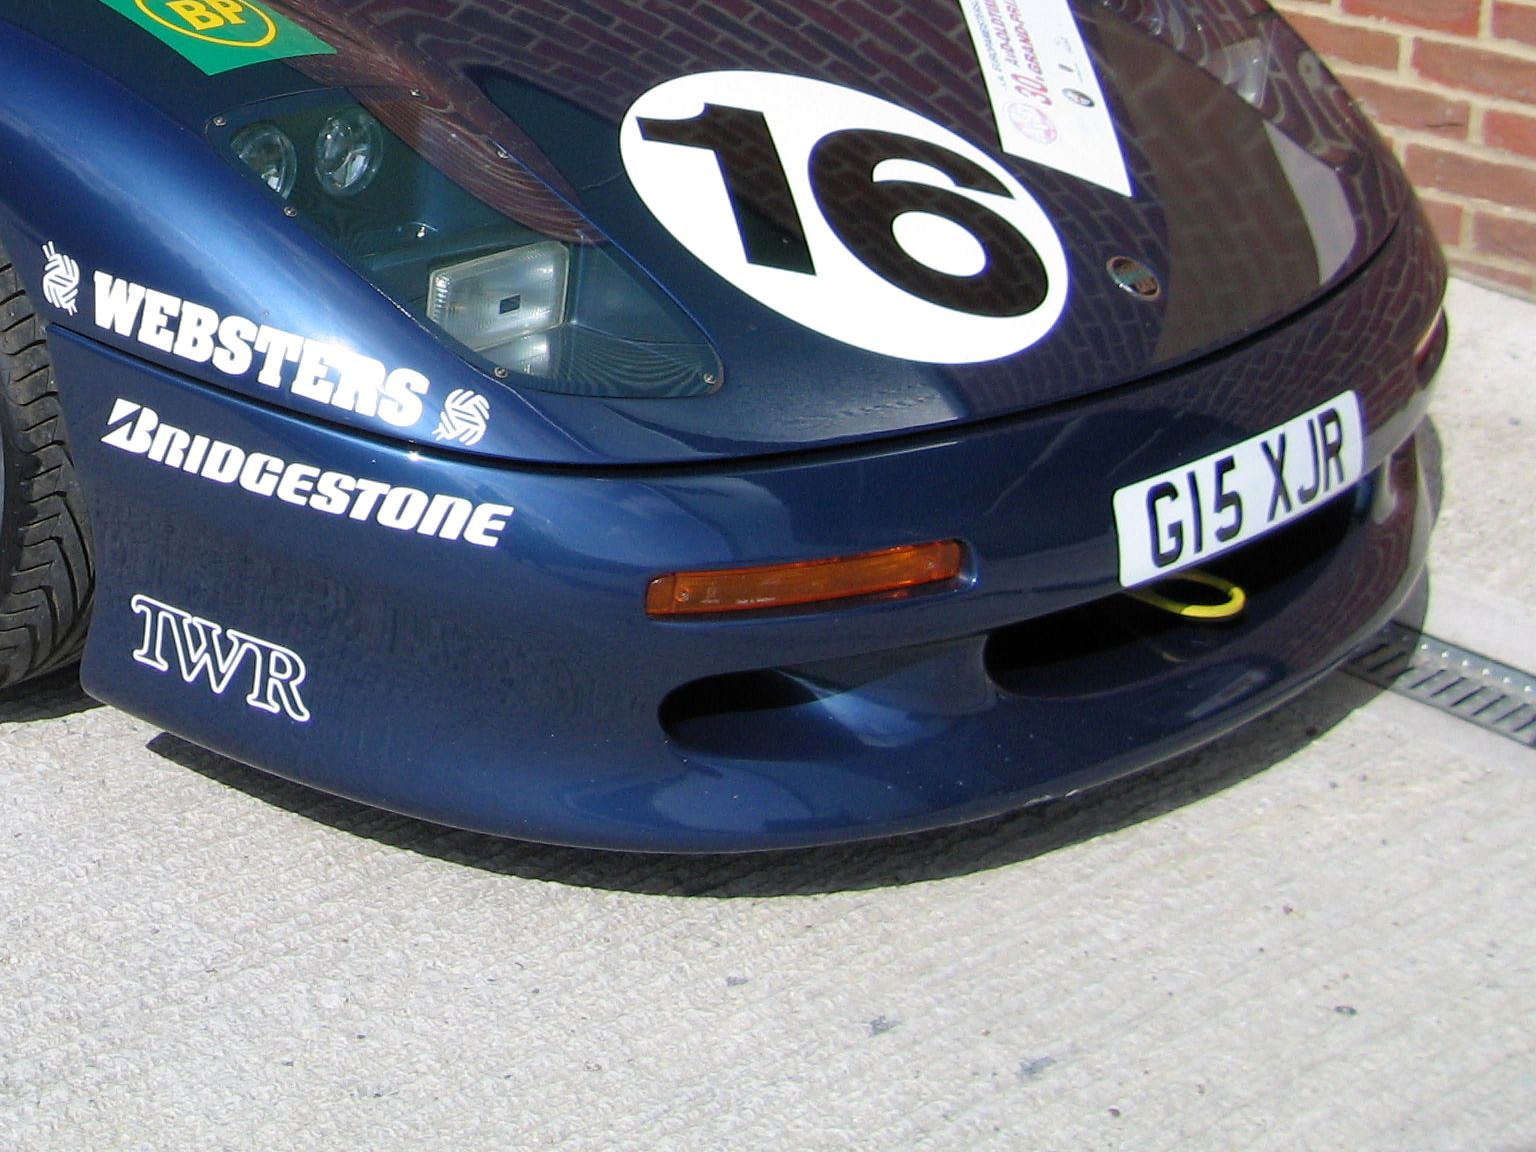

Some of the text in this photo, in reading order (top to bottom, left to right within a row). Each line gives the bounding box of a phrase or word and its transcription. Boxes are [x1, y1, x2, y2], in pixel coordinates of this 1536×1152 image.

[635, 102, 1049, 318] 16
[93, 270, 429, 430] WEBSTERS
[100, 397, 515, 548] BRIDGESTONE
[1146, 407, 1344, 568] G15 XJR
[130, 593, 310, 722] TWR
